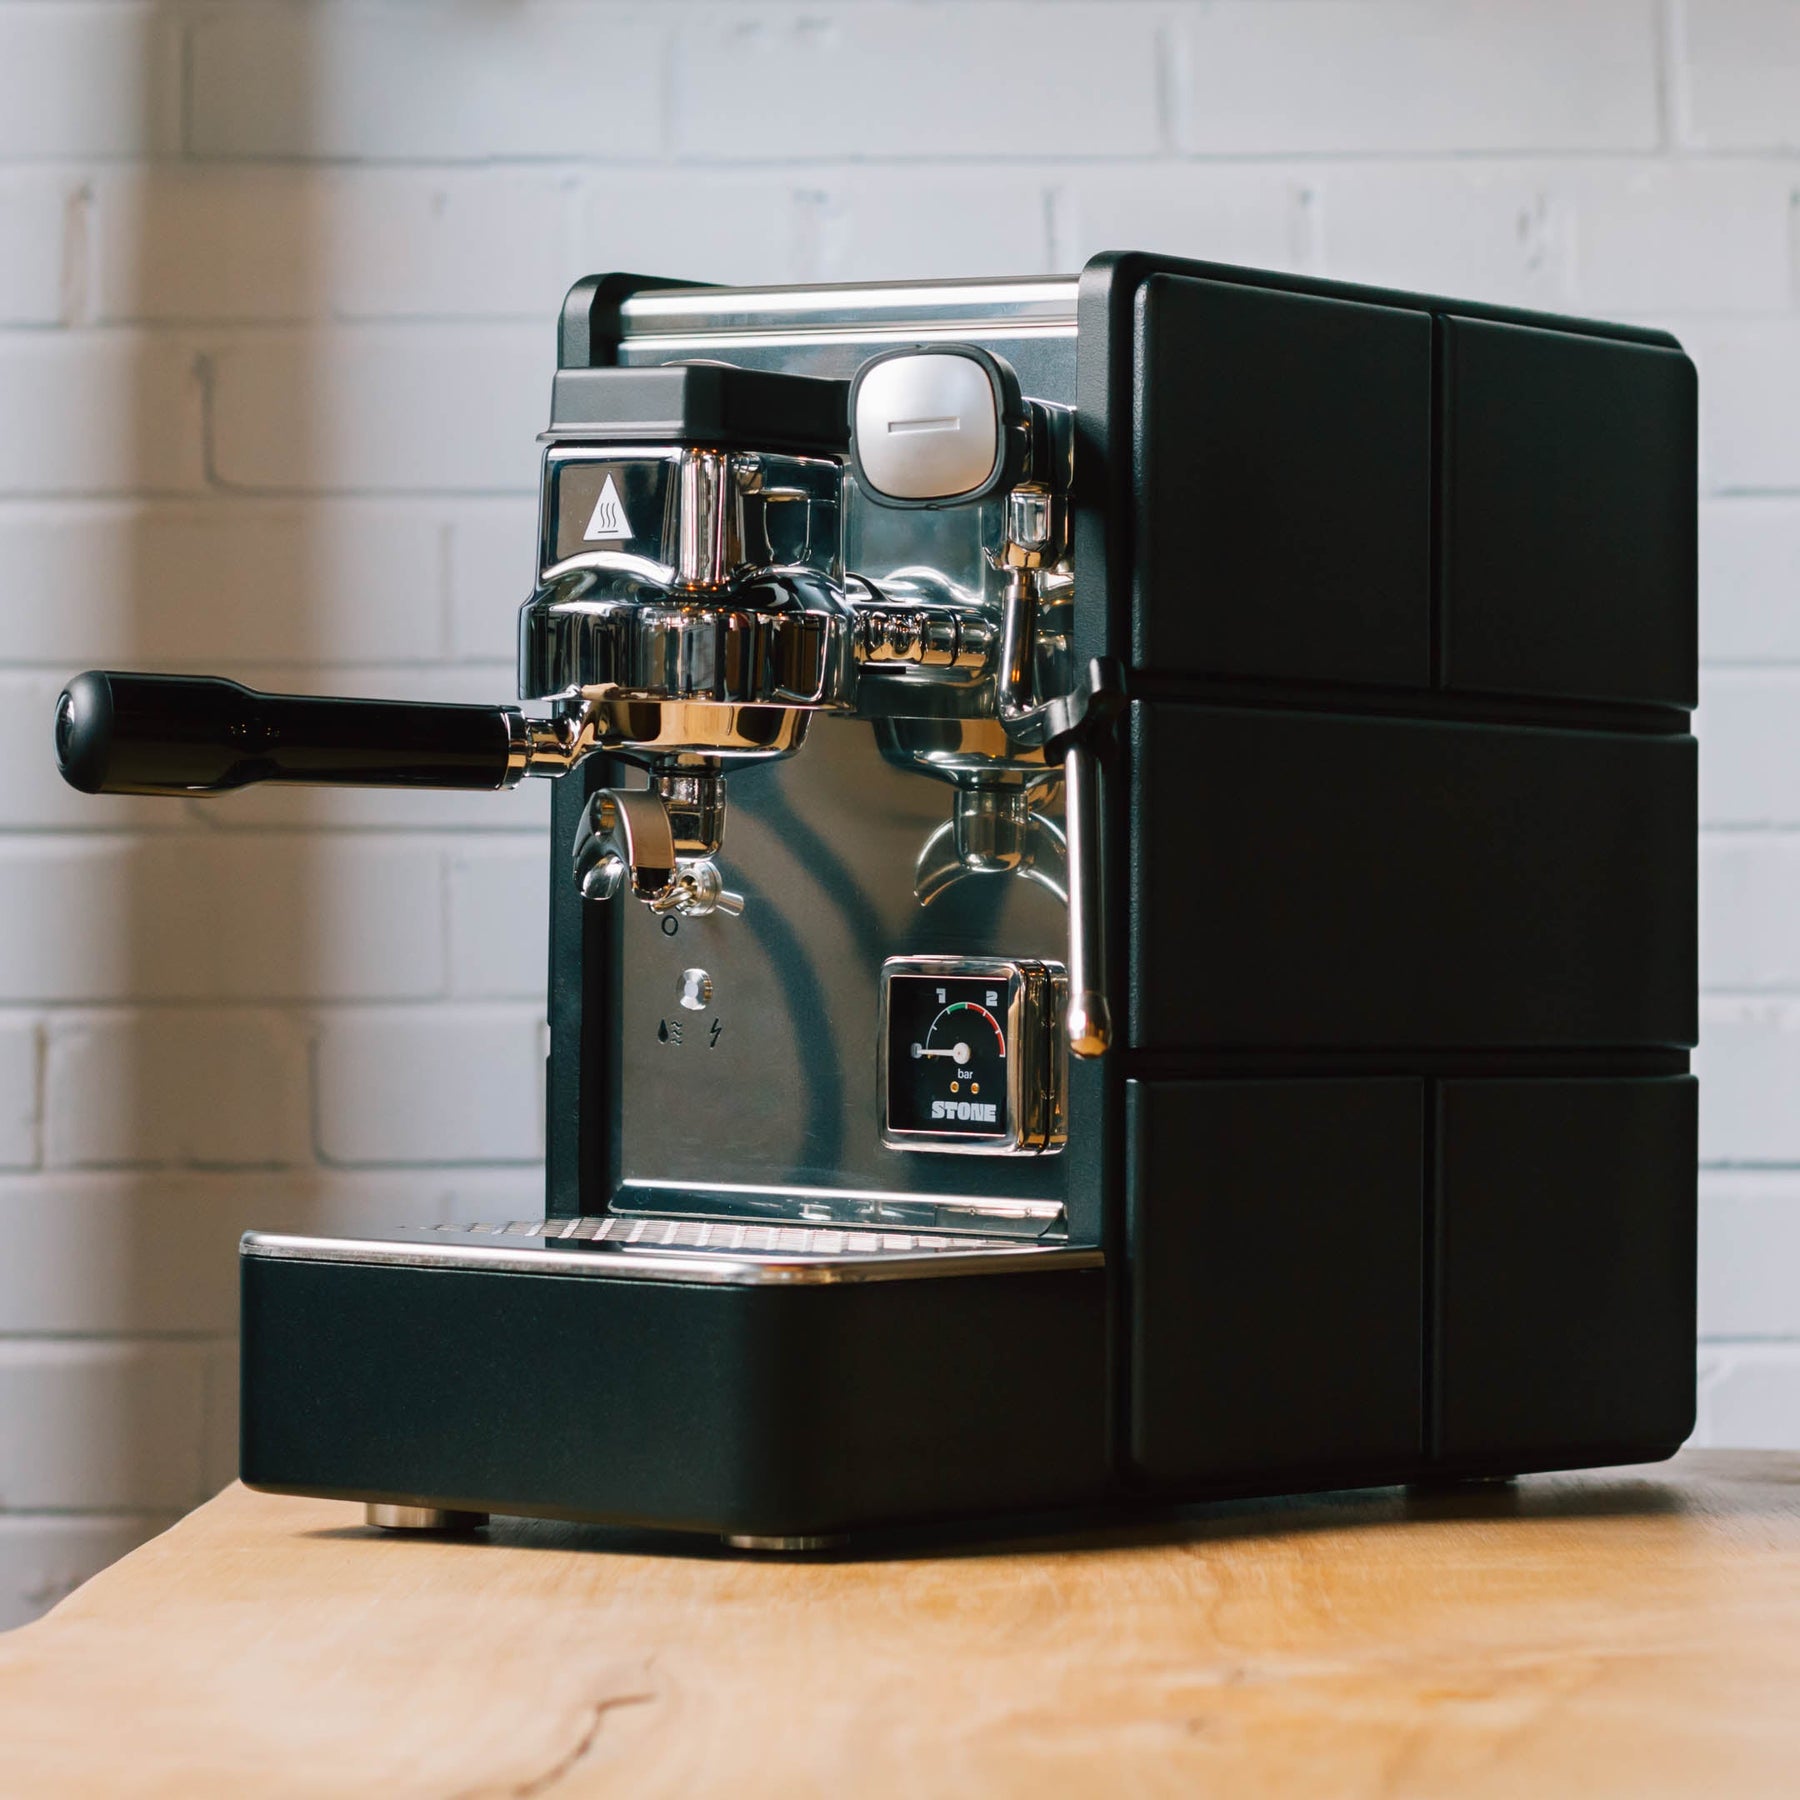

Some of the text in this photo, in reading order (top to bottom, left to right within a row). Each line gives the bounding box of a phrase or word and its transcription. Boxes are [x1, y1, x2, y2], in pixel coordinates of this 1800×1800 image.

[936, 988, 947, 1004] 1
[985, 991, 998, 1007] 2
[957, 1068, 974, 1079] bar
[931, 1101, 997, 1123] STONE
